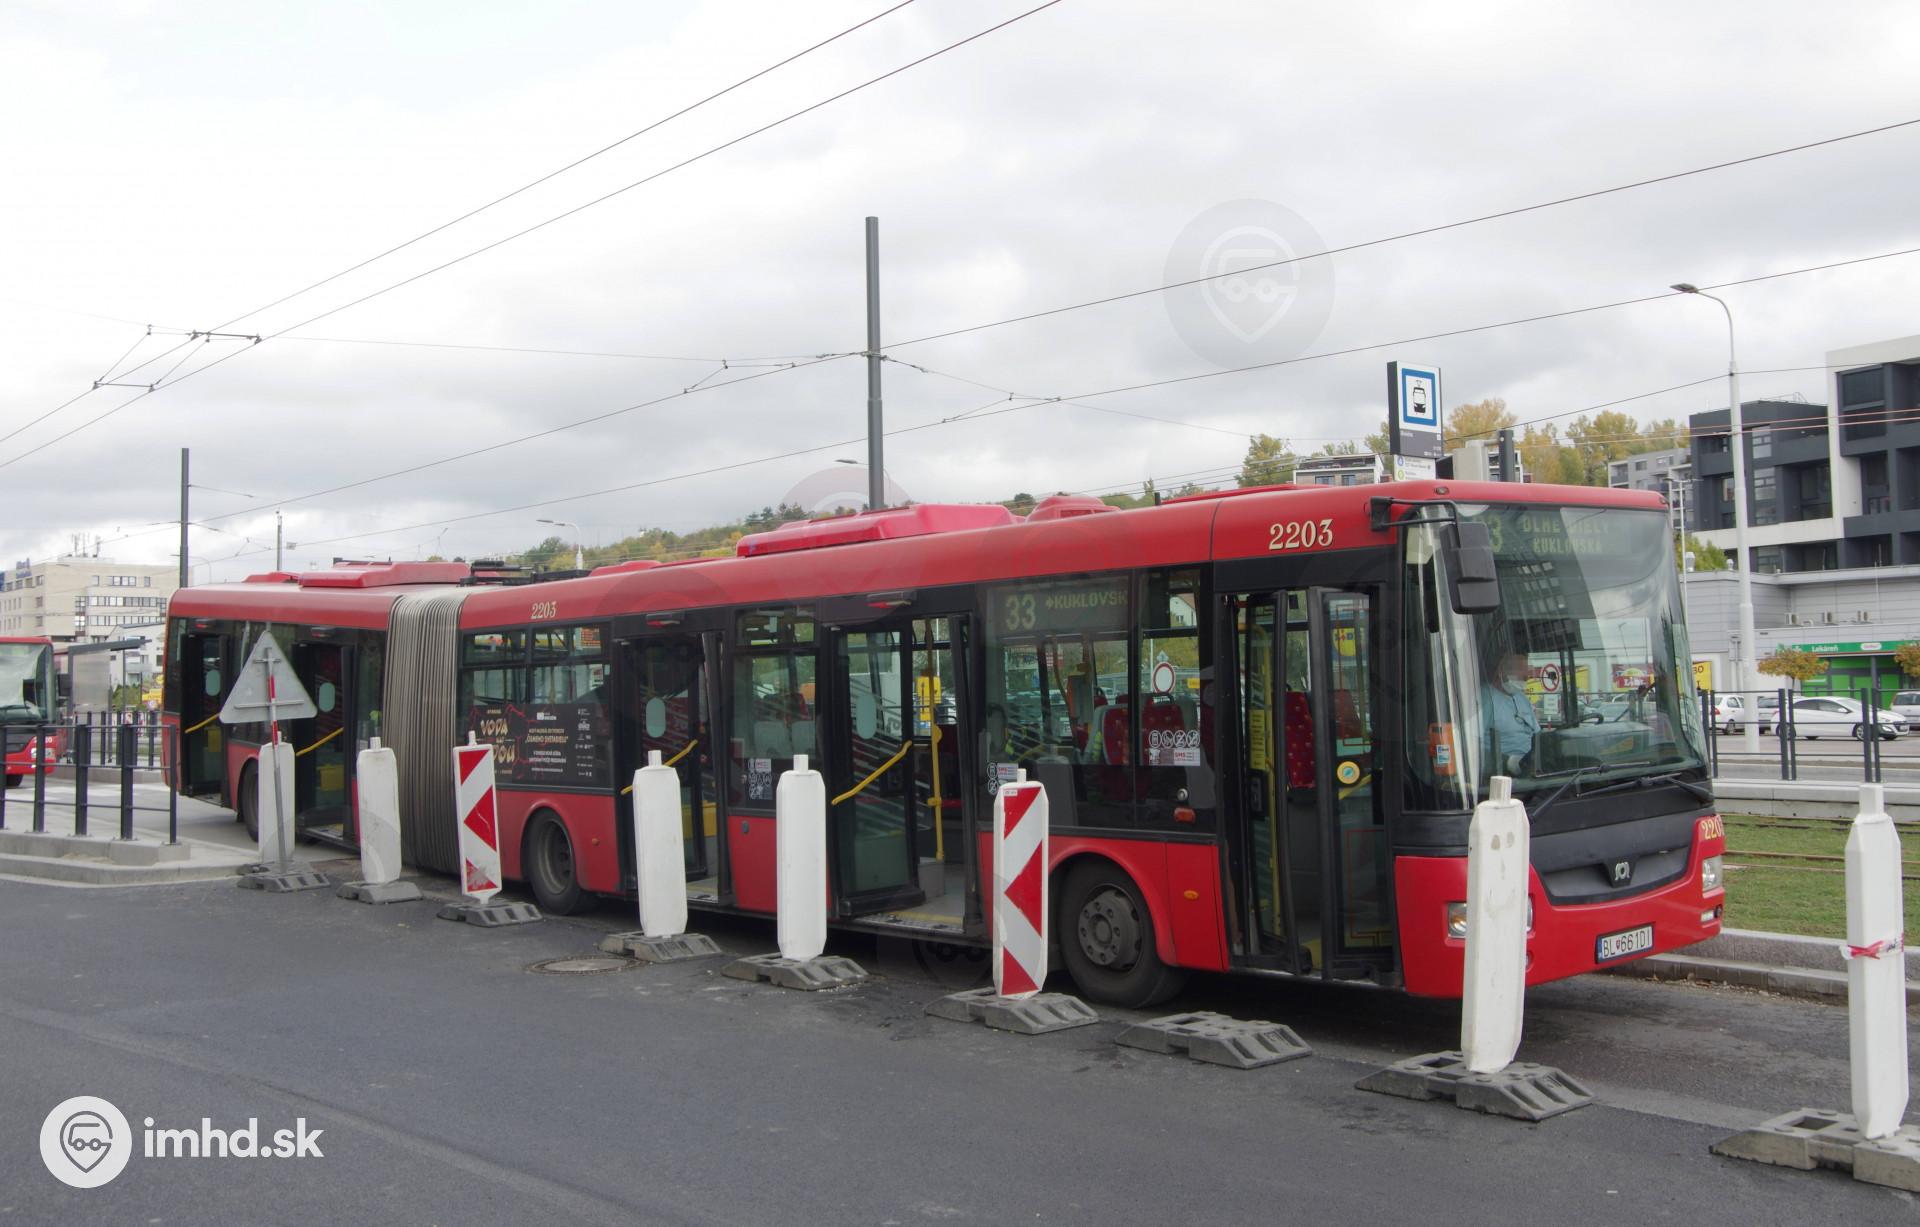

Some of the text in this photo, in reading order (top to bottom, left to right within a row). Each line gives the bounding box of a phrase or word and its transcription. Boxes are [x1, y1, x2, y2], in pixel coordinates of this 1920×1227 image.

[1268, 518, 1334, 550] 2203
[530, 600, 557, 620] 2203
[1005, 593, 1036, 631] 33
